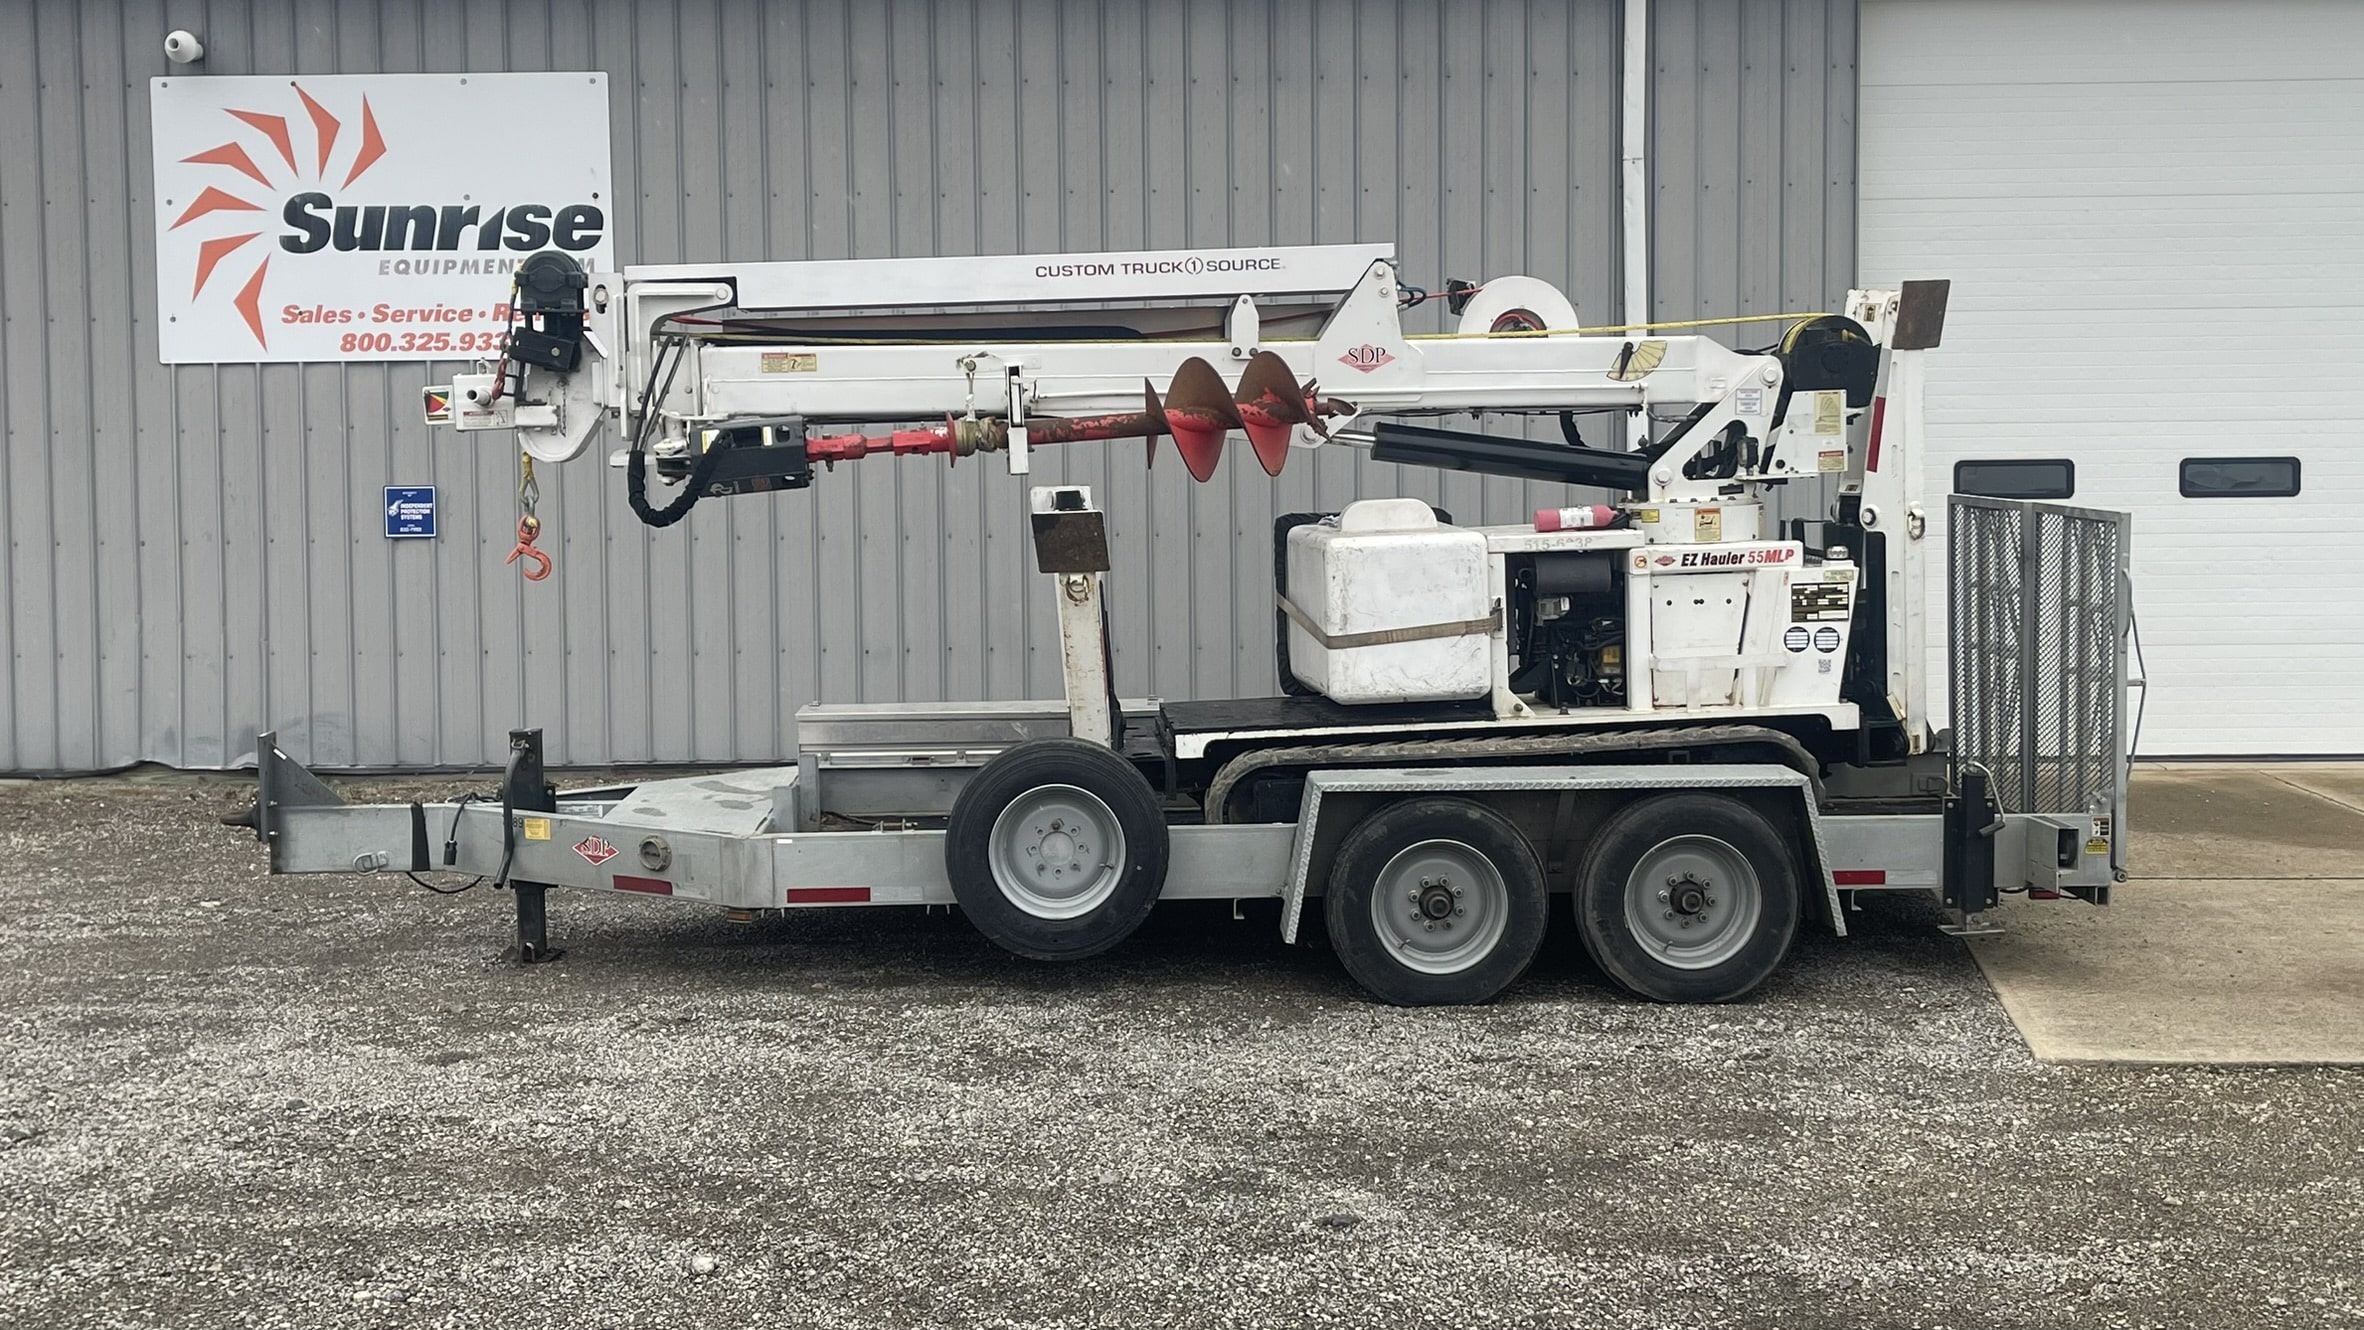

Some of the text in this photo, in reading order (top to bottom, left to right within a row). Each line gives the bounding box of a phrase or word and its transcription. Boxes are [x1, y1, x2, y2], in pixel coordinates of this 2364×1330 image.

[278, 191, 604, 254] Sunrise
[378, 257, 595, 276] EQUIPMENM
[1035, 263, 1115, 278] CUSTOM
[1121, 261, 1183, 275] TRUCK
[1206, 258, 1281, 272] SOURCE
[281, 304, 352, 324] Sales
[371, 303, 473, 323] Service
[340, 332, 506, 353] 800.325.933
[1348, 346, 1386, 364] SDP
[1680, 553, 1699, 567] EZ
[1700, 551, 1745, 566] Hauler
[1747, 549, 1795, 563] 55MLP
